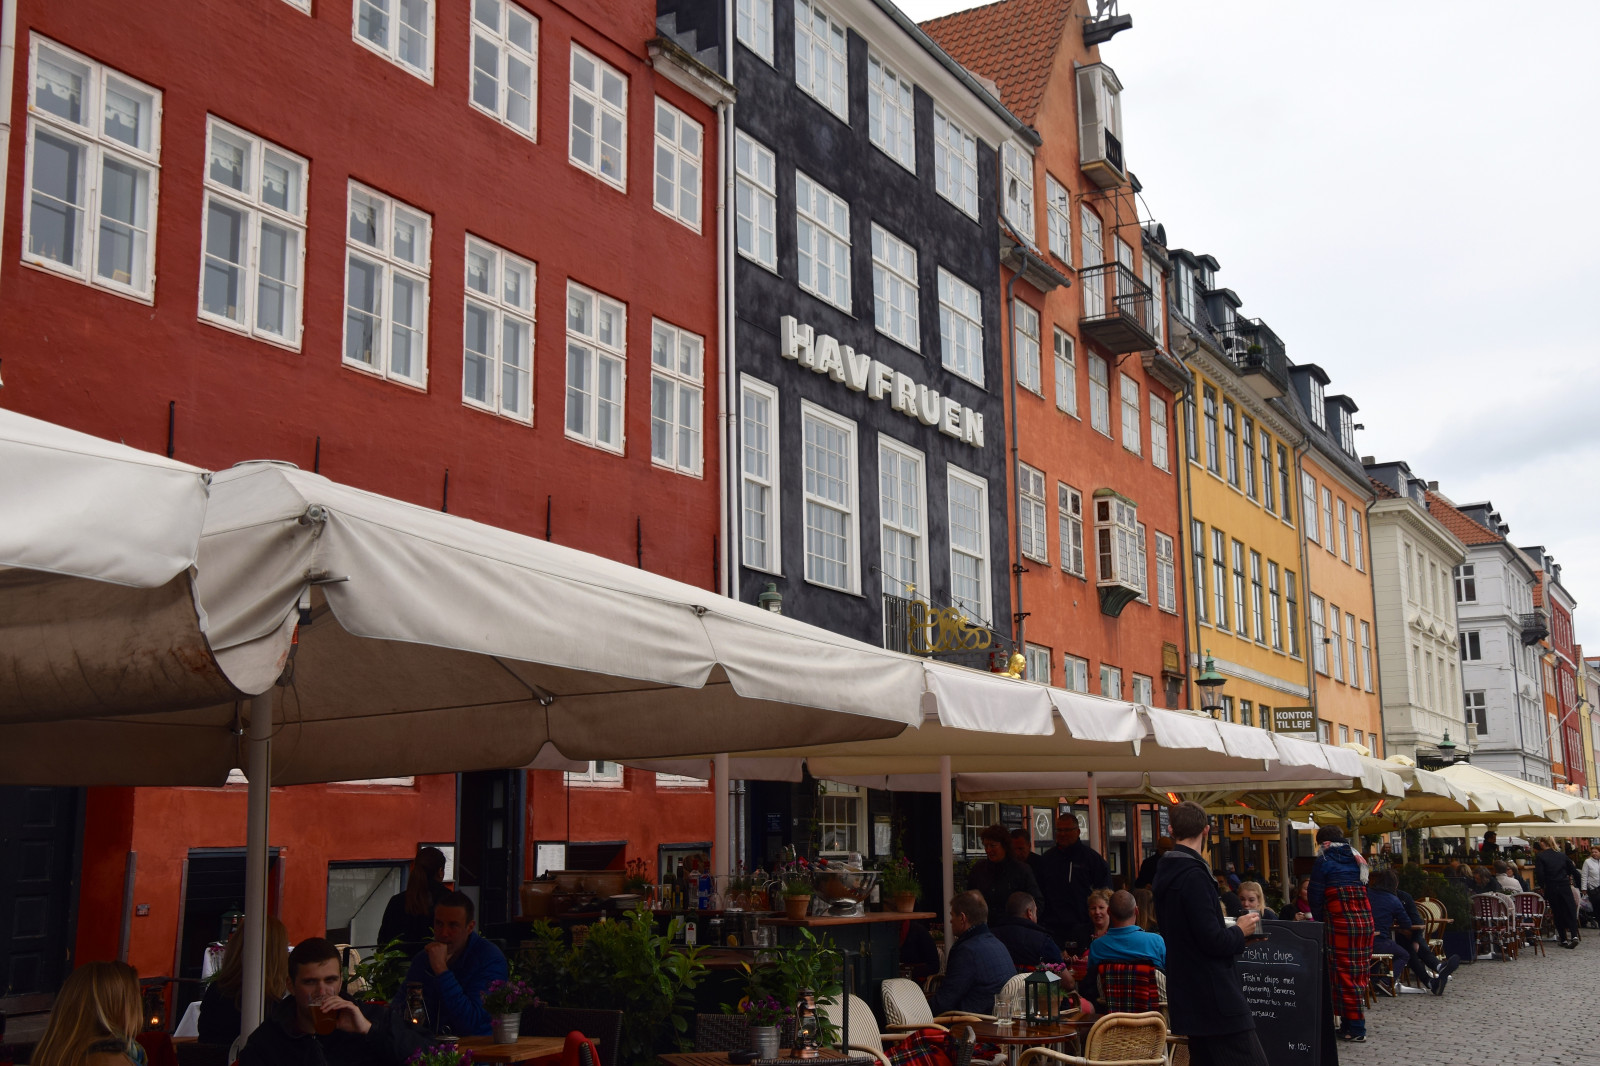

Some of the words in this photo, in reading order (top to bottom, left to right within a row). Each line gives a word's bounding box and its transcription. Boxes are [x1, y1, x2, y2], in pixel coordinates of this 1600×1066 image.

[780, 315, 984, 448] HAVFRUEN
[1276, 711, 1313, 720] KONTOR
[1276, 721, 1290, 729] TIL
[1292, 720, 1311, 730] LEJE
[1273, 950, 1294, 964] chips
[1264, 975, 1280, 987] chips
